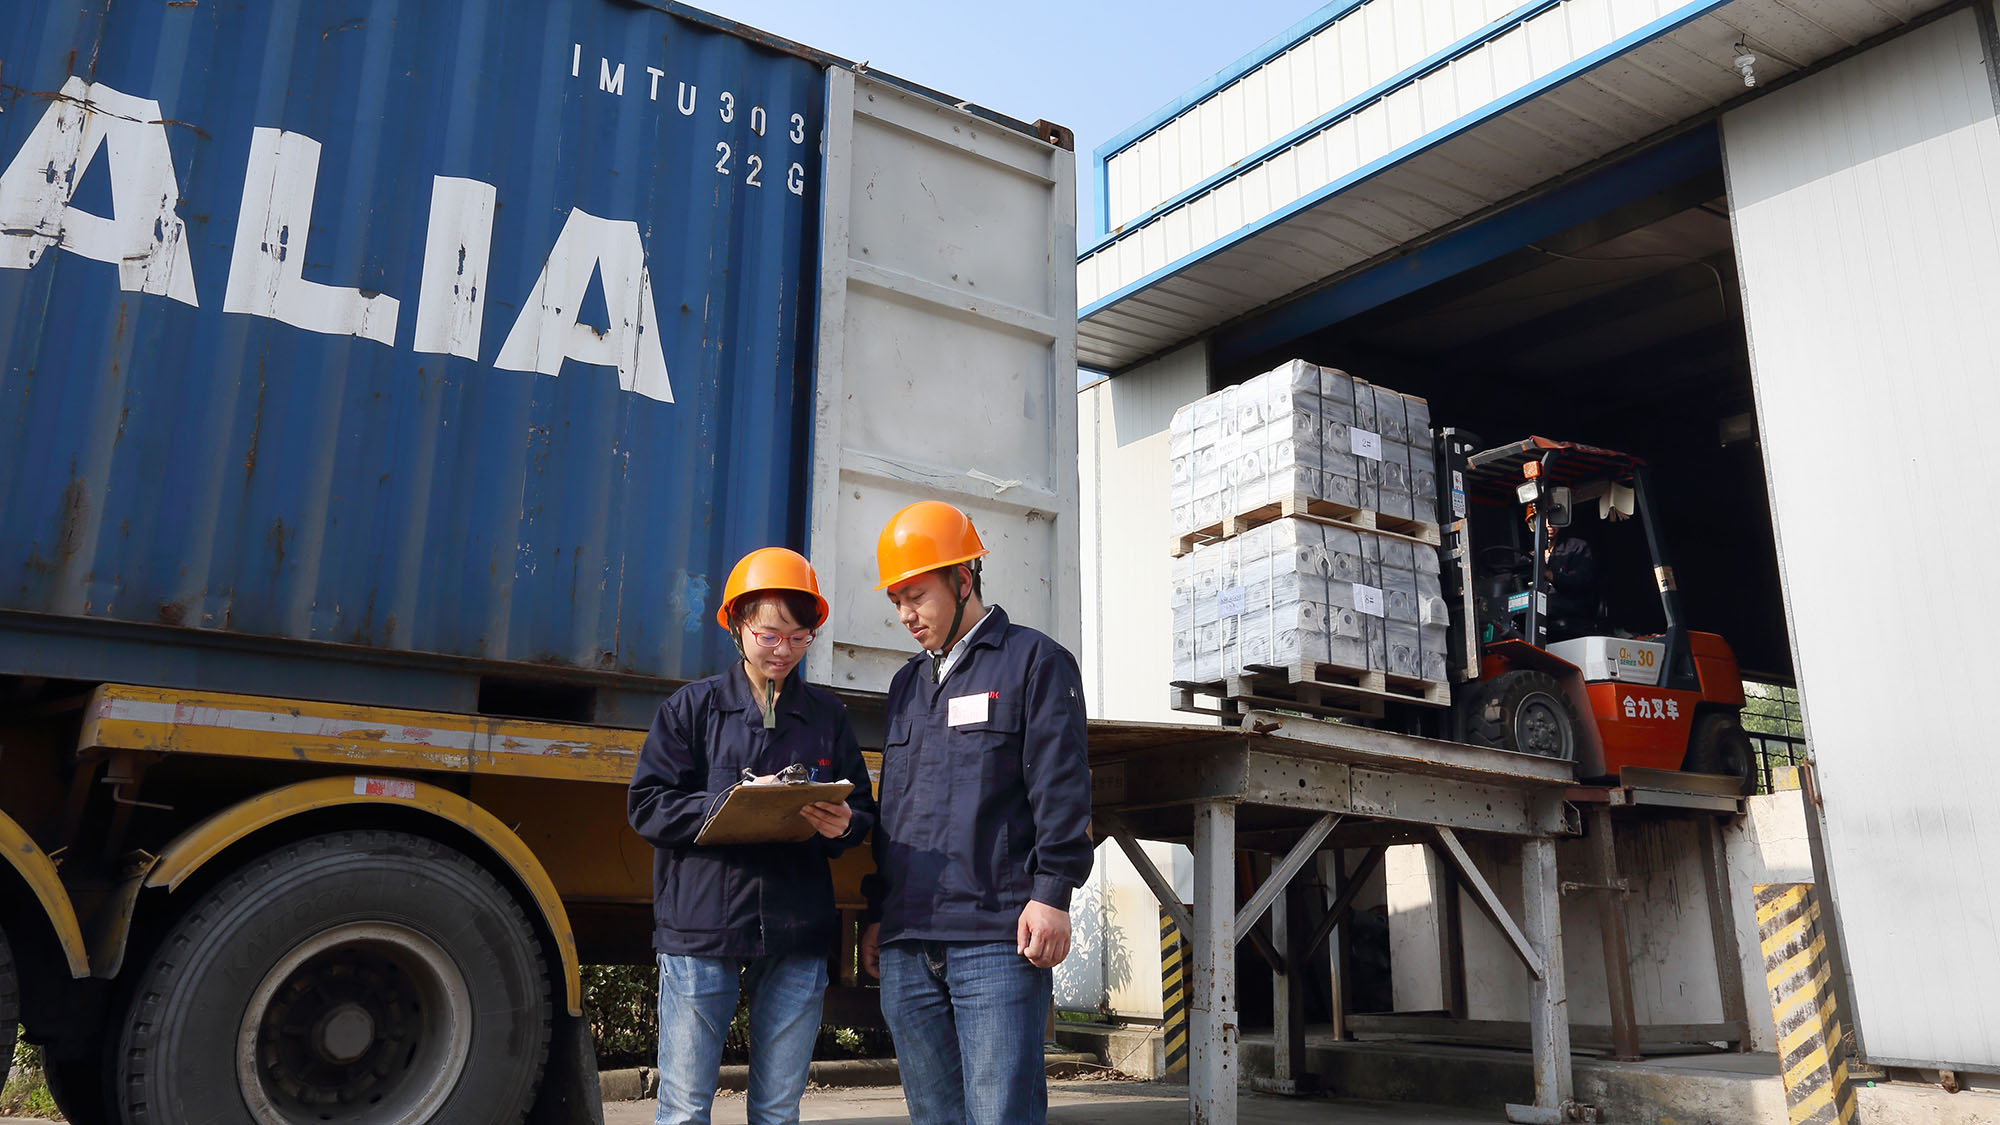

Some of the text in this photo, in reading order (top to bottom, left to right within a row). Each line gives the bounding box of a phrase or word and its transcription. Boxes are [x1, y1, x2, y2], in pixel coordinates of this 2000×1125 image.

[0, 74, 675, 404] ALIA
[1638, 648, 1654, 667] 30
[1622, 695, 1680, 721] 合力叉车
